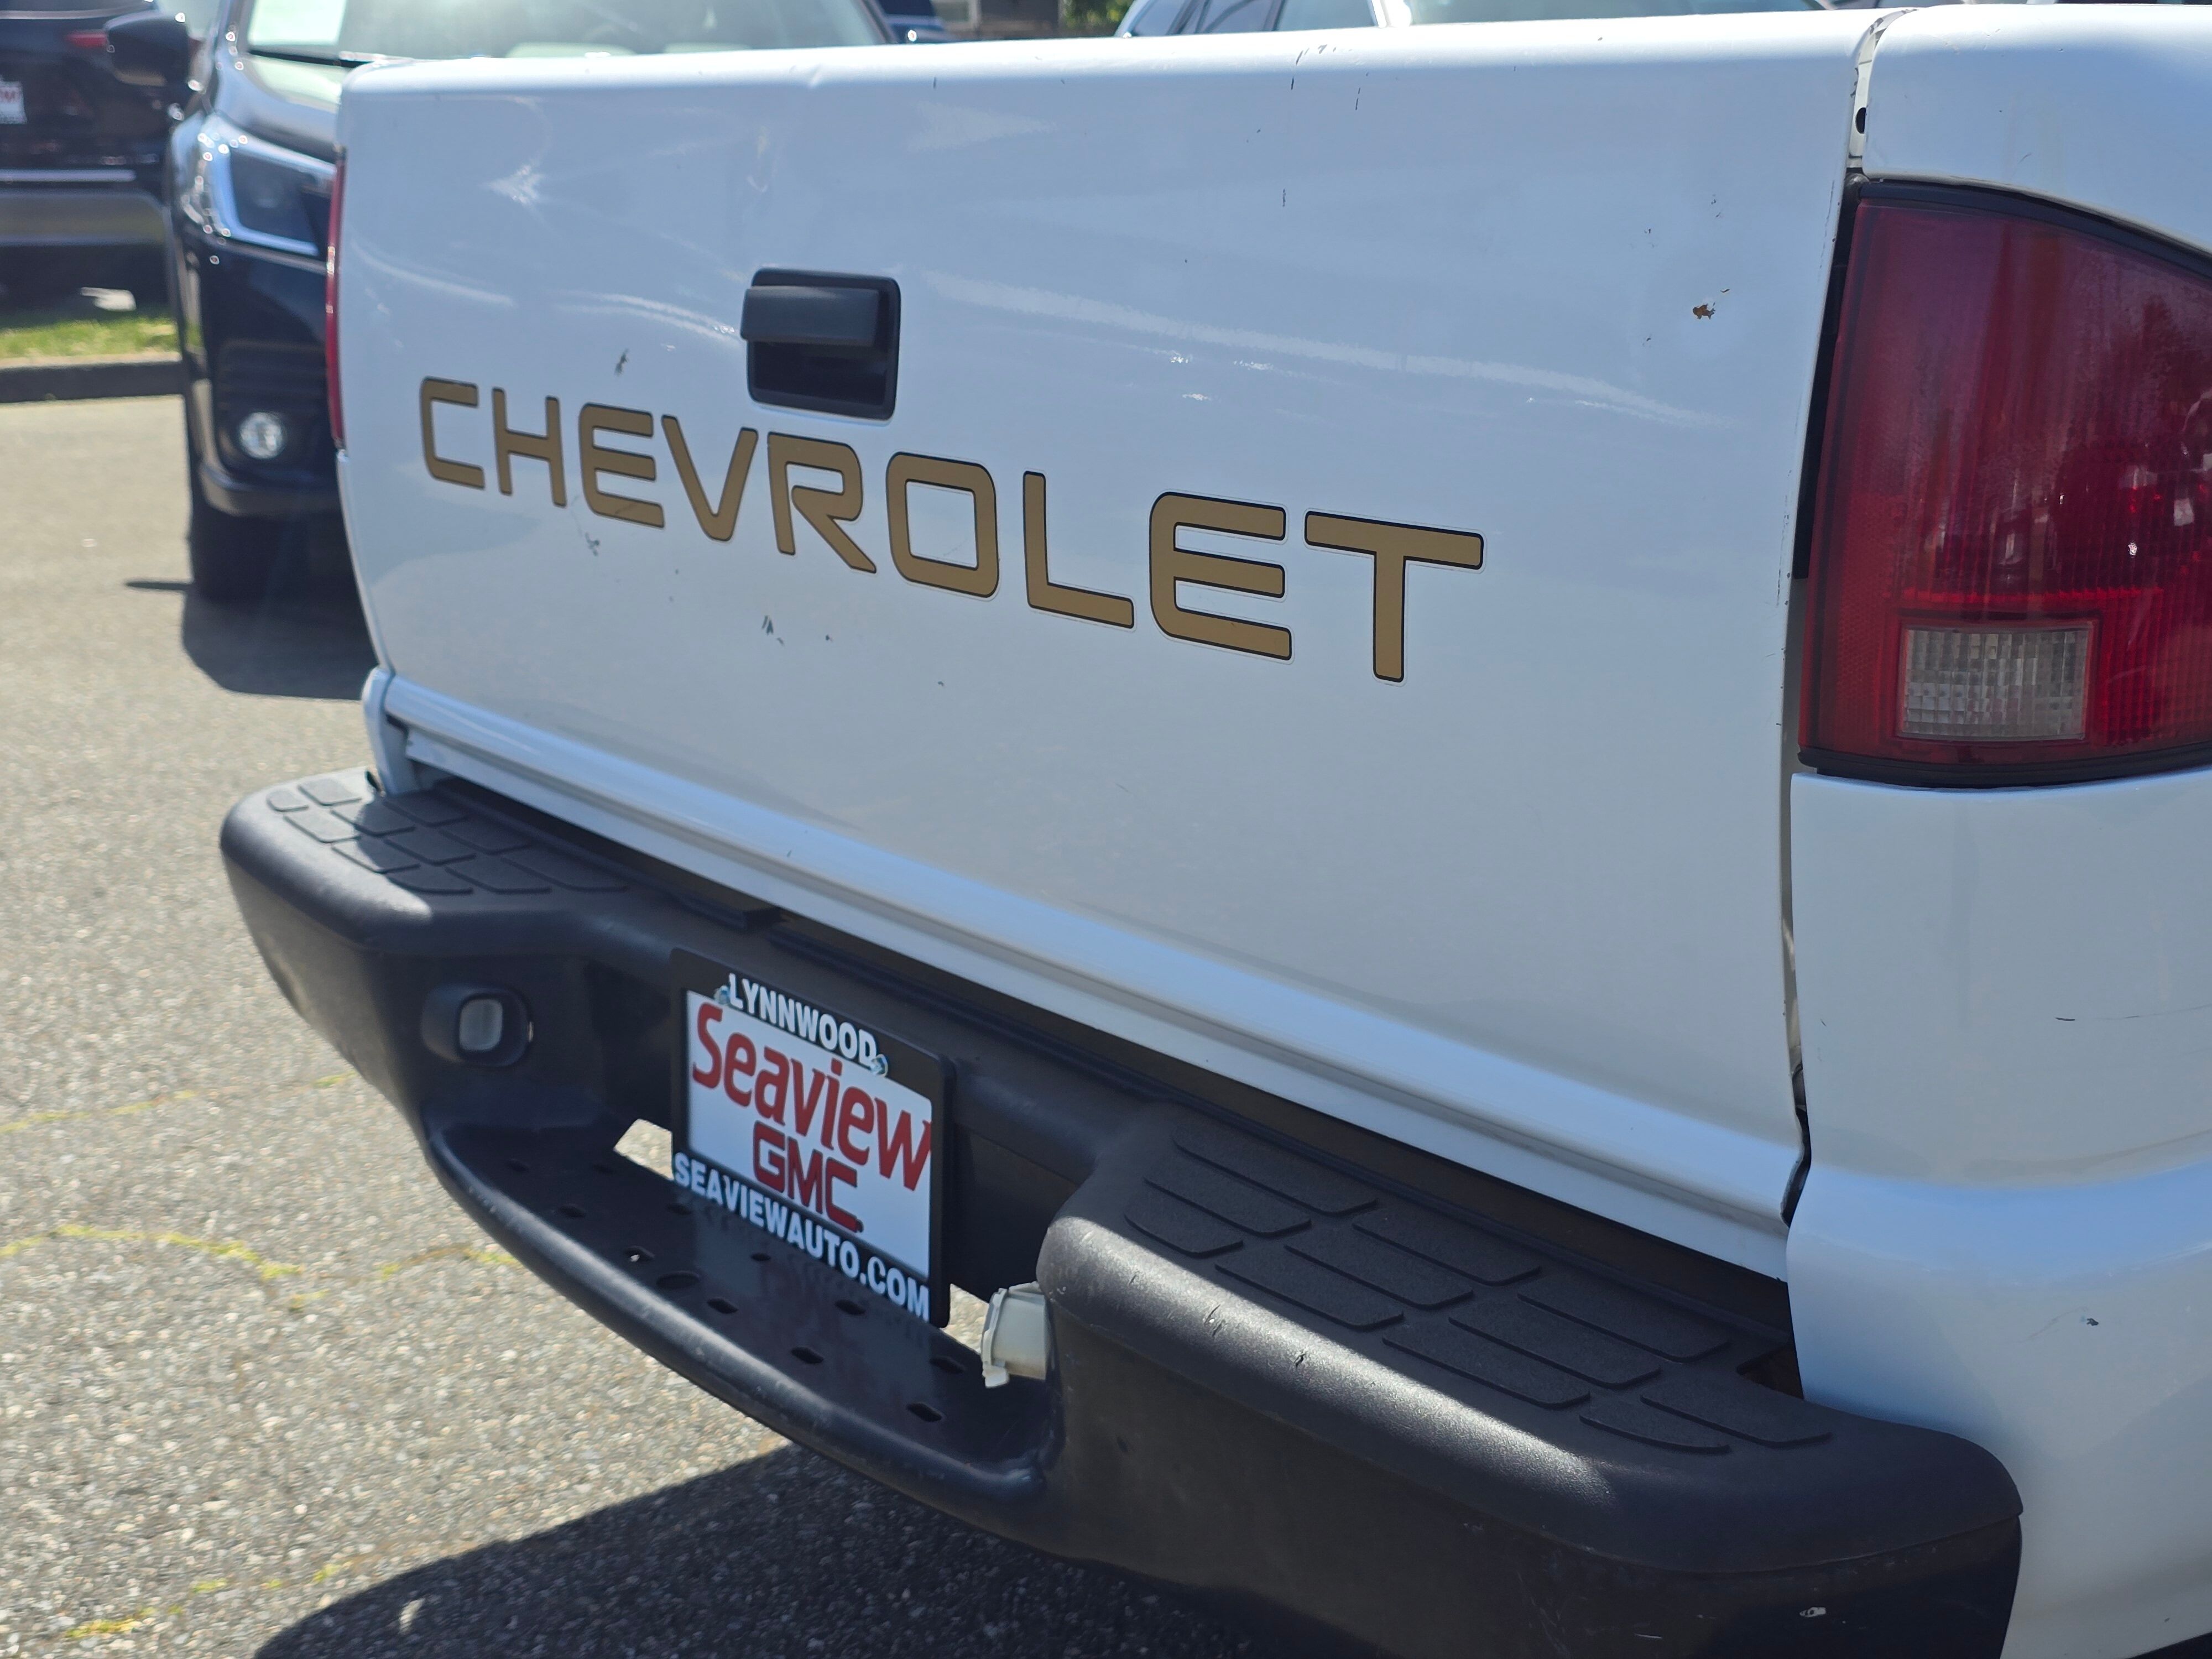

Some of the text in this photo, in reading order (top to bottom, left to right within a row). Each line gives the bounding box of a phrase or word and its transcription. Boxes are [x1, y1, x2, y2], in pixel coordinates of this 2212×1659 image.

[420, 377, 1484, 683] CHEVROLET
[692, 1003, 931, 1191] Seaview
[728, 973, 877, 1065] LYNNWOOD
[673, 1152, 930, 1322] SEAVIEWAUTO.COM
[753, 1120, 862, 1233] GMC
